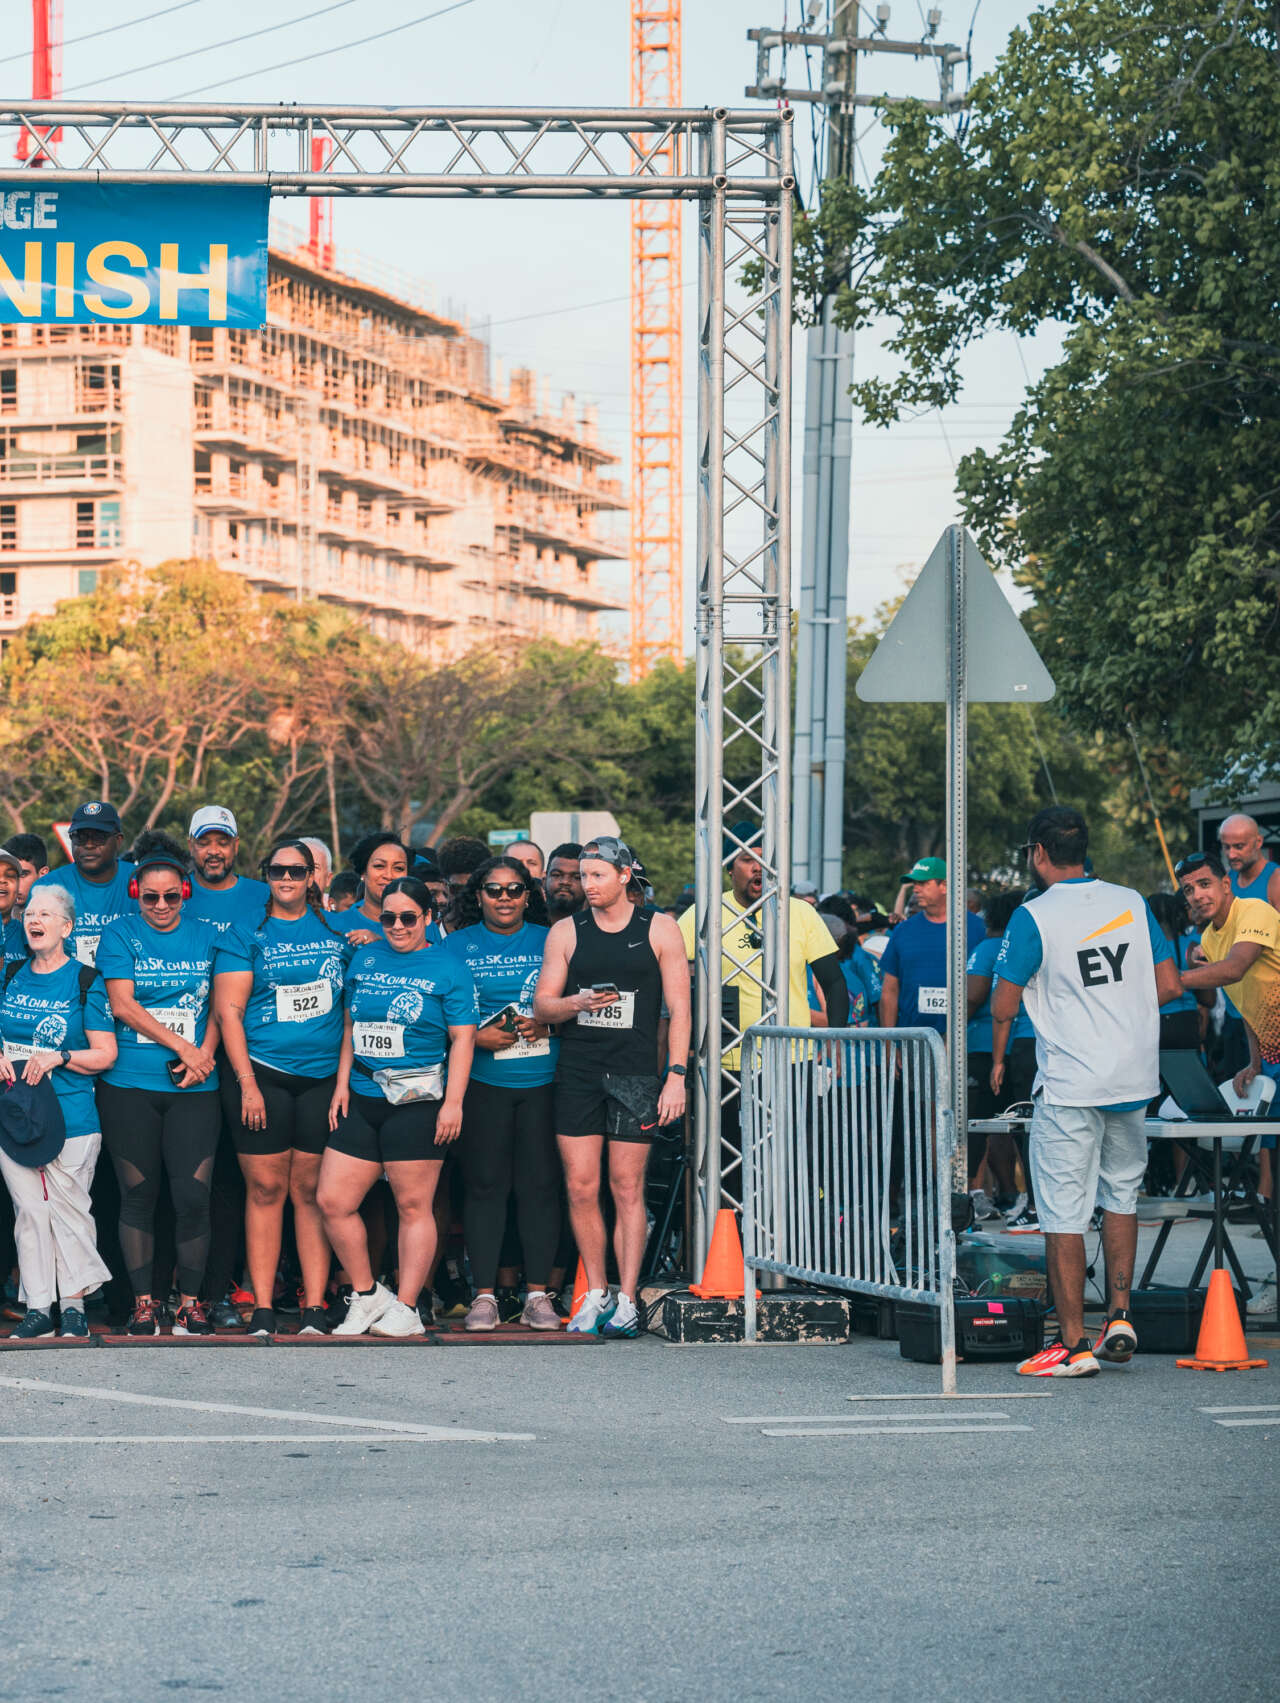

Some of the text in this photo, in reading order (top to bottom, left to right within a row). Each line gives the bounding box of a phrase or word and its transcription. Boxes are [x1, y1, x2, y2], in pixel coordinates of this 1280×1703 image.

[277, 942, 296, 954] 5K
[262, 958, 317, 970] APPLEBY
[486, 954, 502, 965] 5K
[1076, 942, 1130, 988] EY
[136, 980, 188, 988] PPLEBY
[293, 996, 319, 1011] 522
[926, 998, 948, 1008] 162
[361, 1034, 393, 1050] 1789
